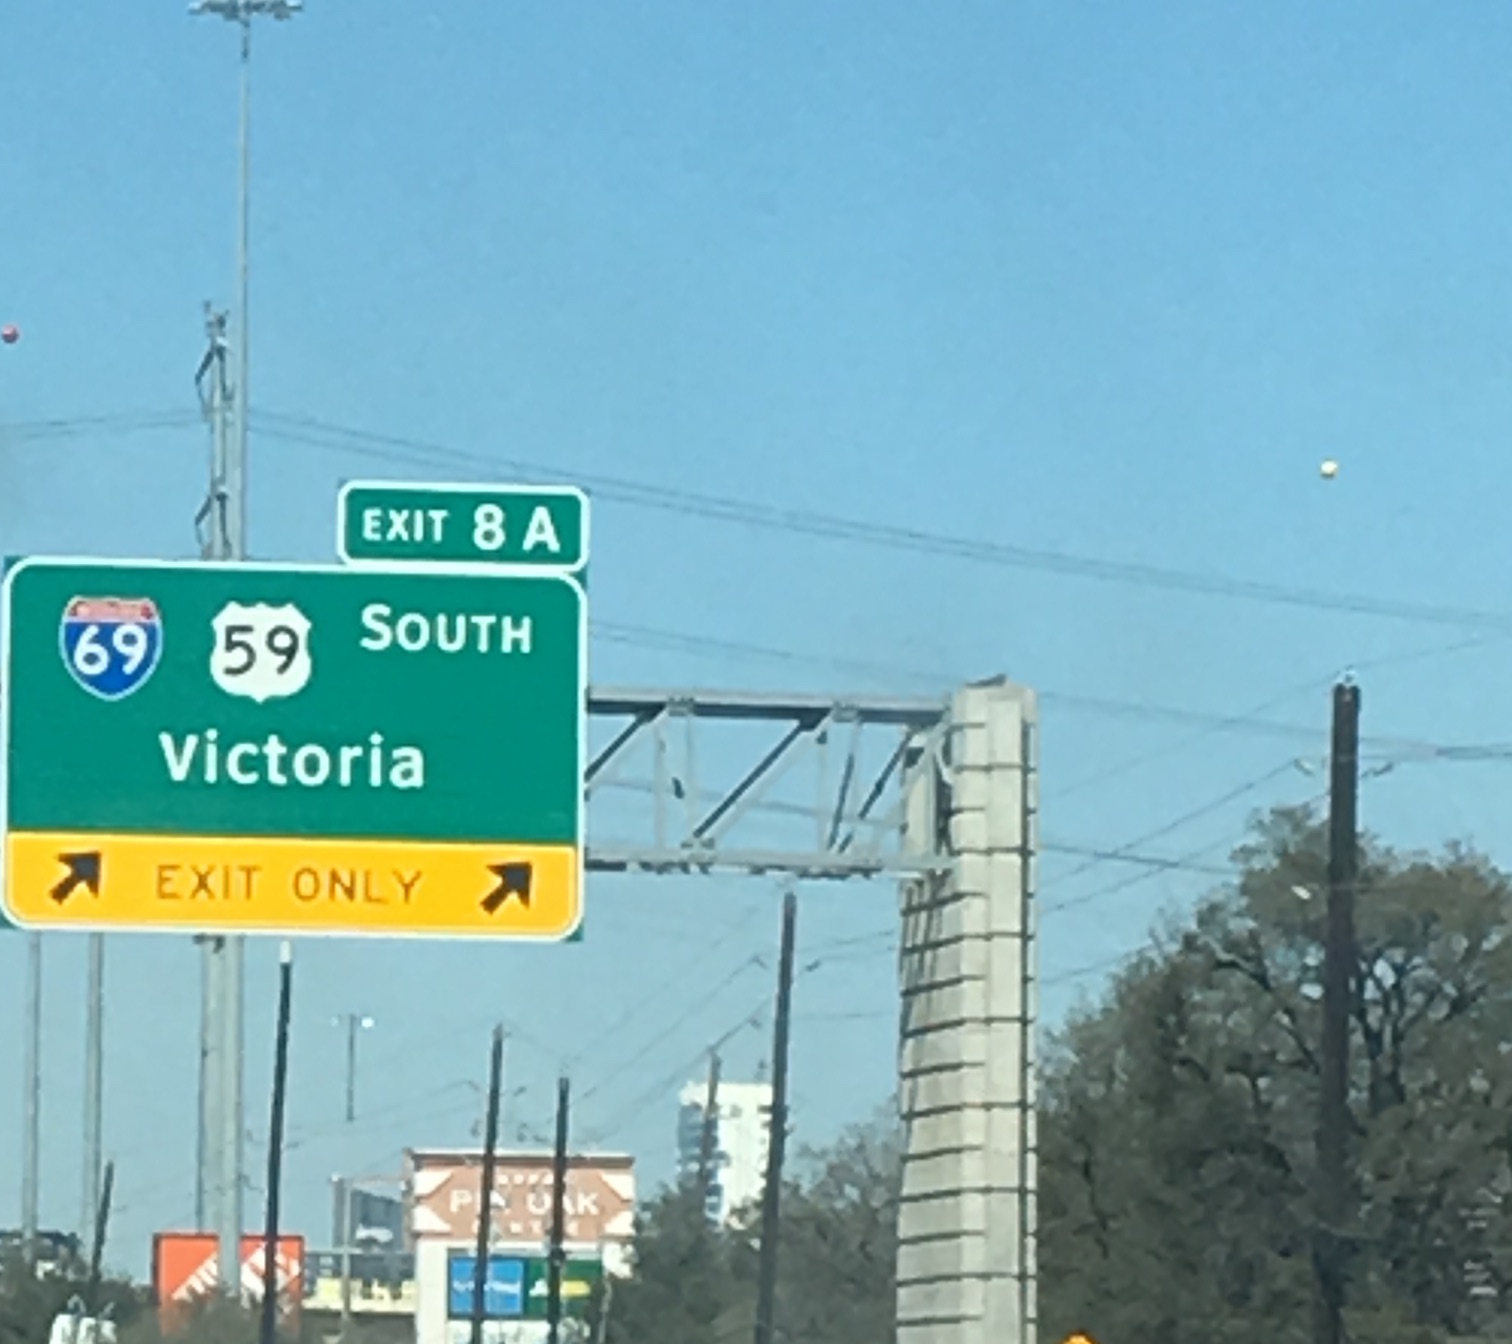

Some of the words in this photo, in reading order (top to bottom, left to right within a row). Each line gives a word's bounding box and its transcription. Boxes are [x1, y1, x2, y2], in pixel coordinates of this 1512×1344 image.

[362, 507, 449, 543] EXIT
[472, 502, 507, 552] 8
[521, 505, 562, 553] A
[71, 622, 148, 677] 69
[223, 623, 300, 677] 59
[359, 602, 532, 654] SOUTH
[158, 727, 425, 789] Victoria
[155, 863, 261, 901] EXIT
[292, 866, 423, 905] ONLY
